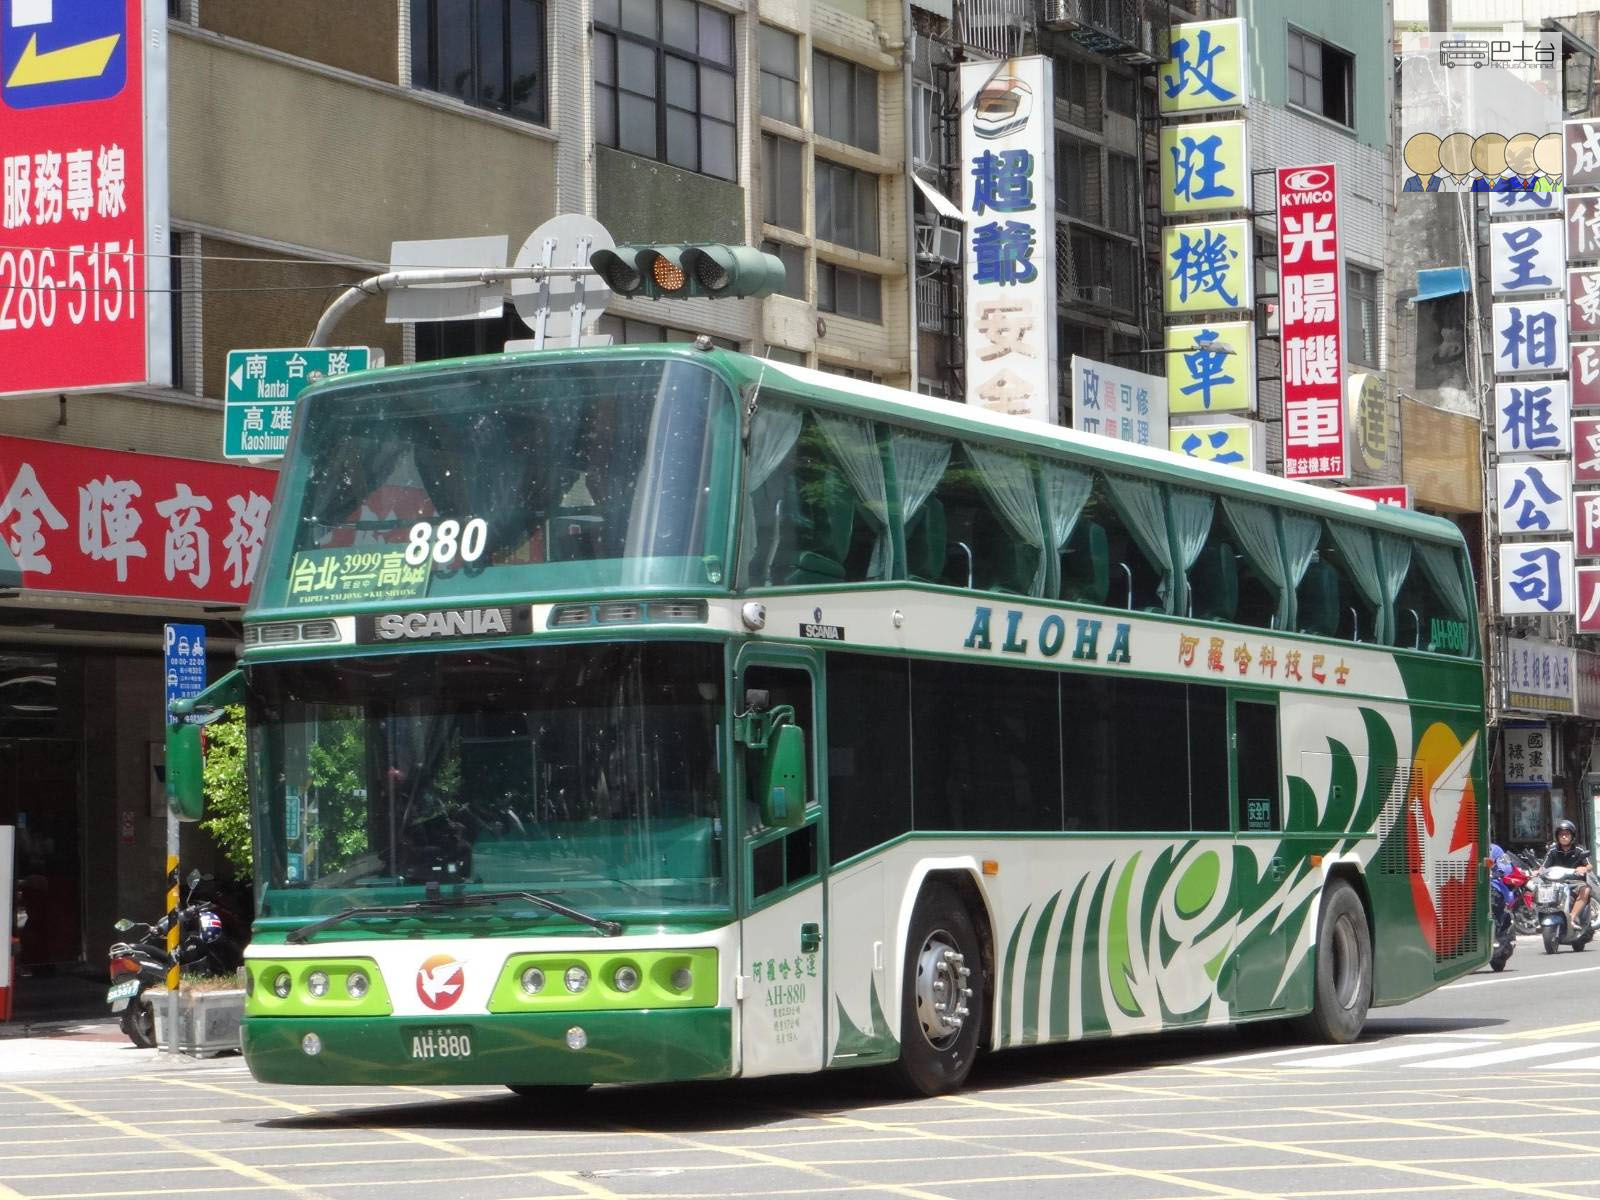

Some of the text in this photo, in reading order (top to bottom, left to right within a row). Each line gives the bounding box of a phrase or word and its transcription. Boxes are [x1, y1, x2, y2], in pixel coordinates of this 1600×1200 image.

[2, 142, 127, 230] 服務專線
[1281, 190, 1333, 207] KYMCO
[0, 239, 135, 330] 286-5151
[1283, 212, 1340, 448] 光陽機車
[246, 351, 350, 379] 南台路
[257, 379, 289, 399] Nantai
[243, 406, 292, 431] 高雄
[404, 517, 488, 565] 880
[292, 556, 341, 594] 台北
[341, 553, 383, 575] 3999
[376, 551, 428, 588] 高雄
[380, 608, 508, 640] SCANIA
[805, 624, 840, 641] SCANIA
[963, 606, 1132, 664] ALOHA
[1431, 617, 1466, 649] AH-880
[166, 626, 176, 656] P
[1178, 632, 1351, 687] 阿羅哈科技巴士
[752, 954, 818, 984] 阿羅哈客運
[765, 983, 806, 1008] AH-880
[412, 1035, 472, 1058] AH-880
